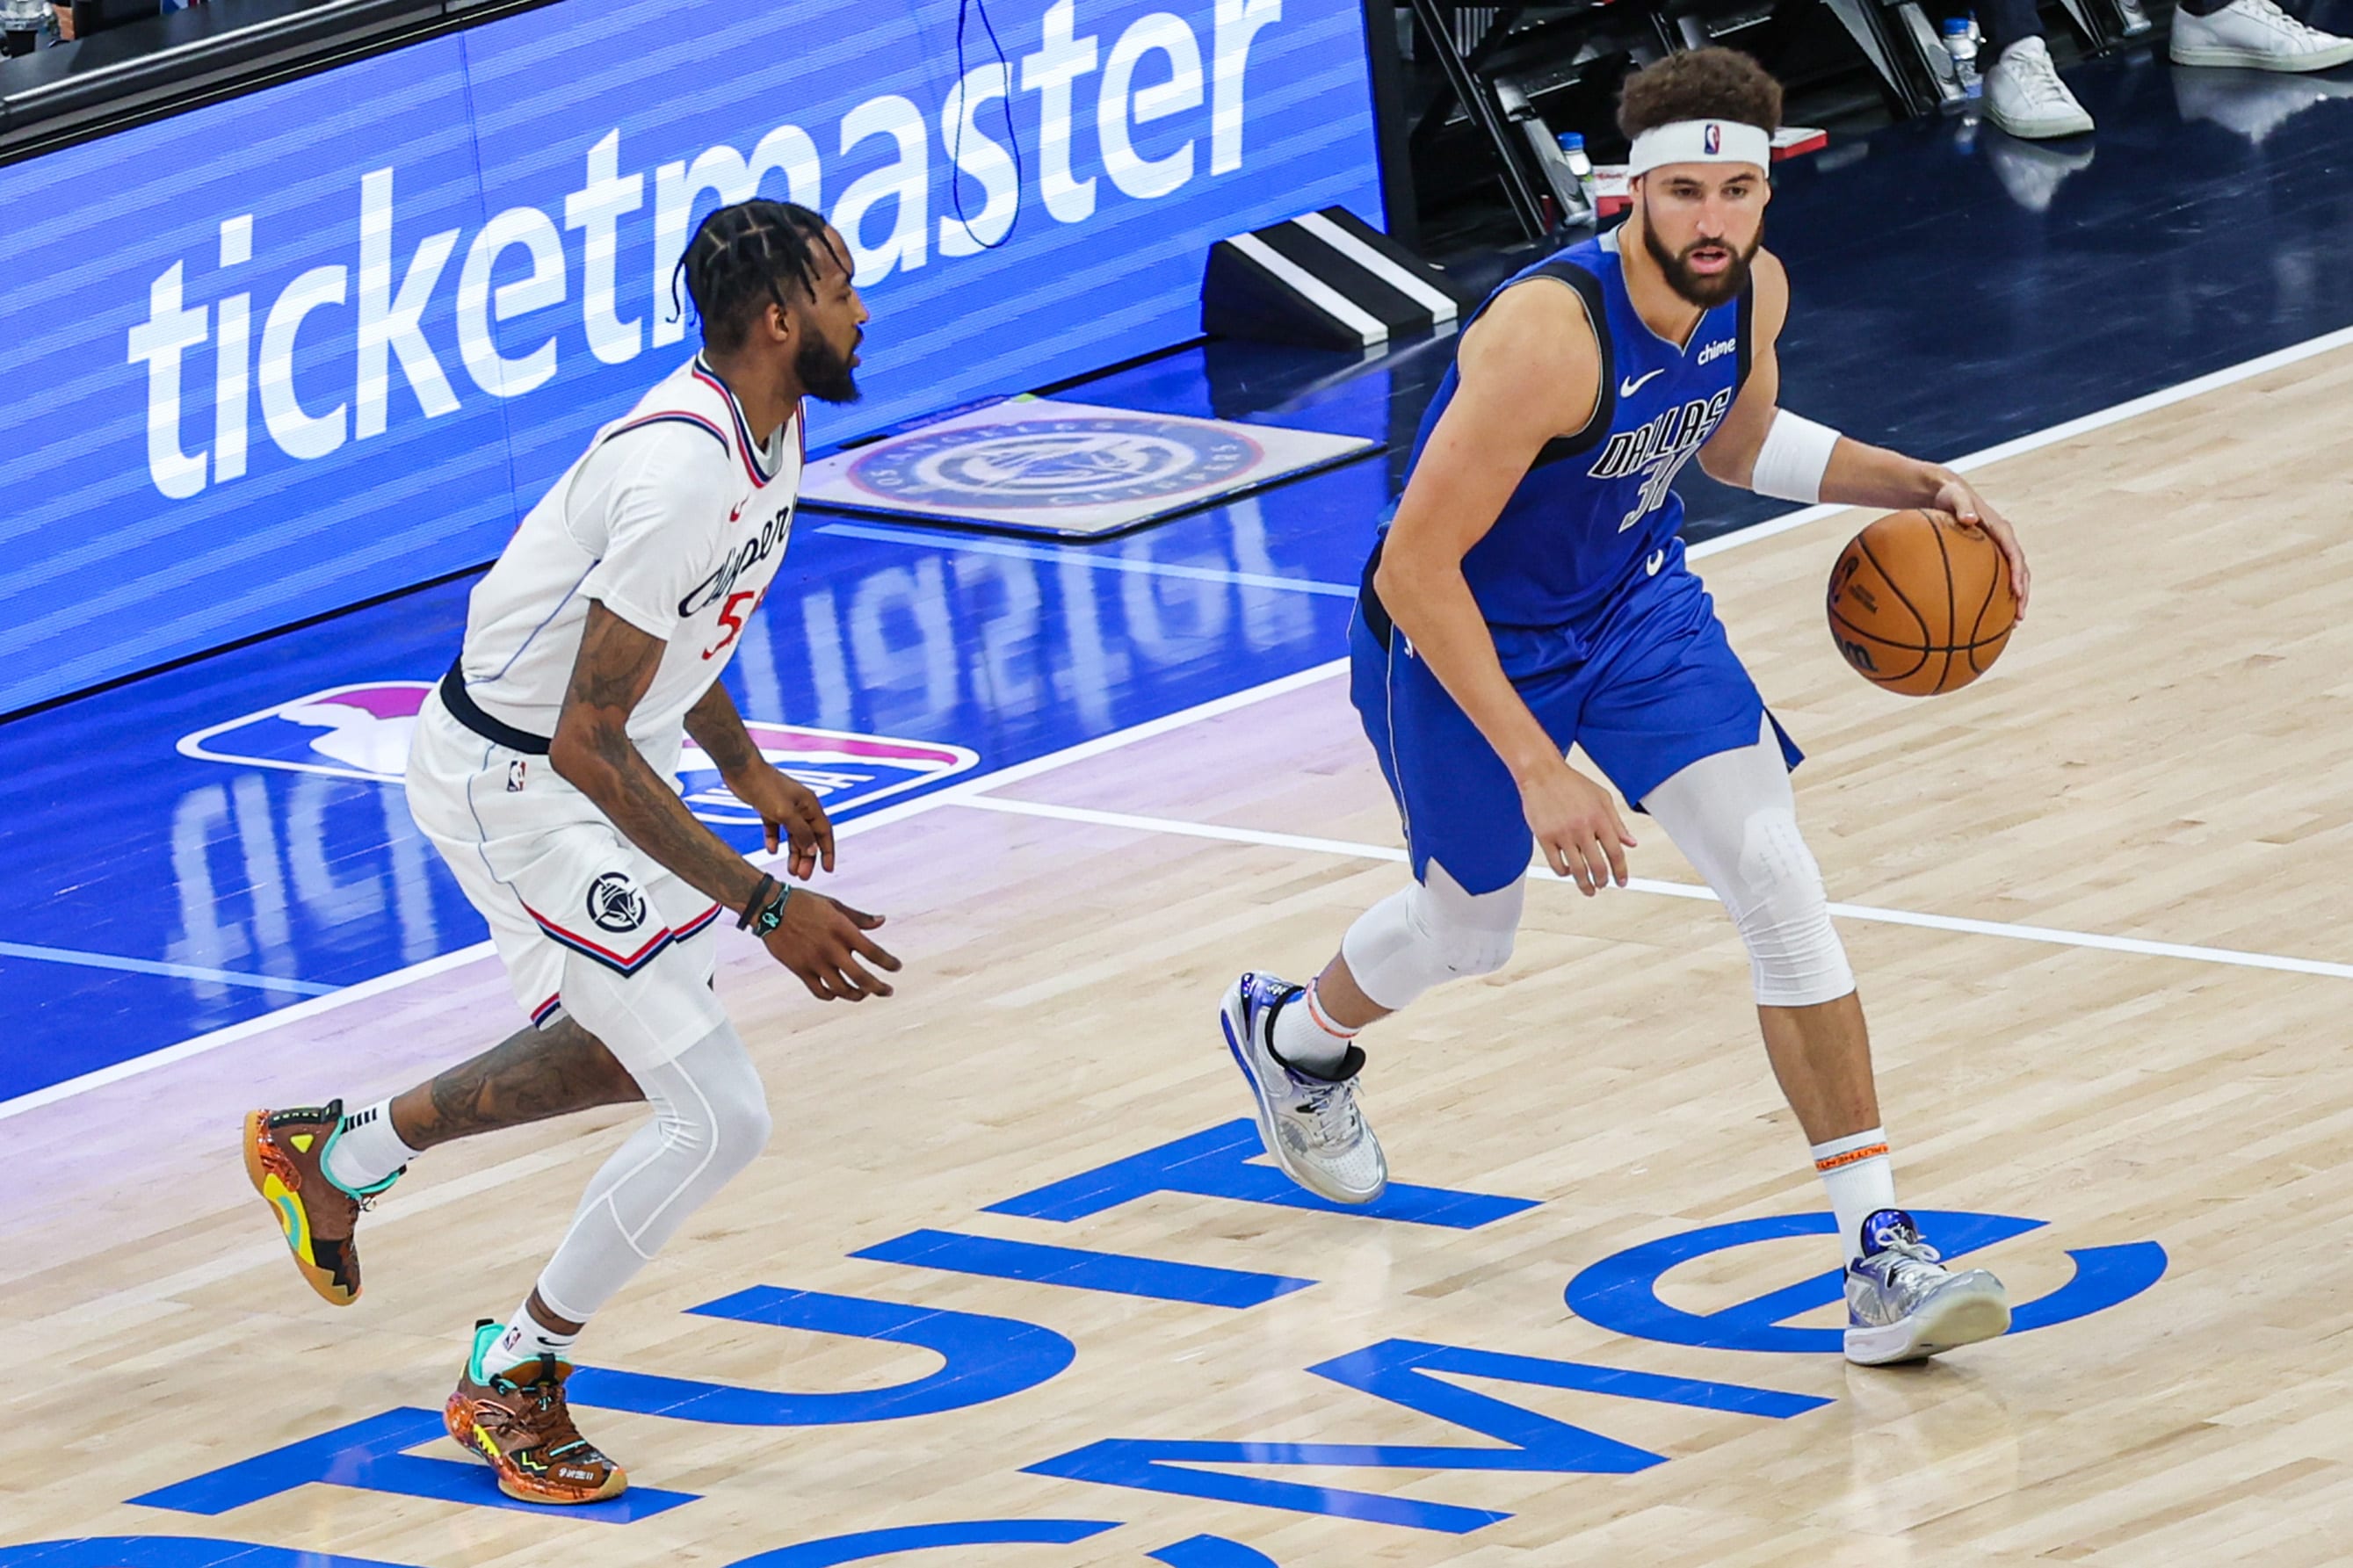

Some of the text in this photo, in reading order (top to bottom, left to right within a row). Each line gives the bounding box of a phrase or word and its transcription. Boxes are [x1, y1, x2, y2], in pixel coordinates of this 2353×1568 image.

[127, 0, 1281, 500] ticketmaster
[1698, 337, 1736, 365] chime
[1587, 387, 1732, 480] DALLAS
[1618, 445, 1701, 534] 31
[678, 505, 791, 618] Clipper
[702, 585, 770, 661] 5
[0, 1117, 1544, 1568] TUIT
